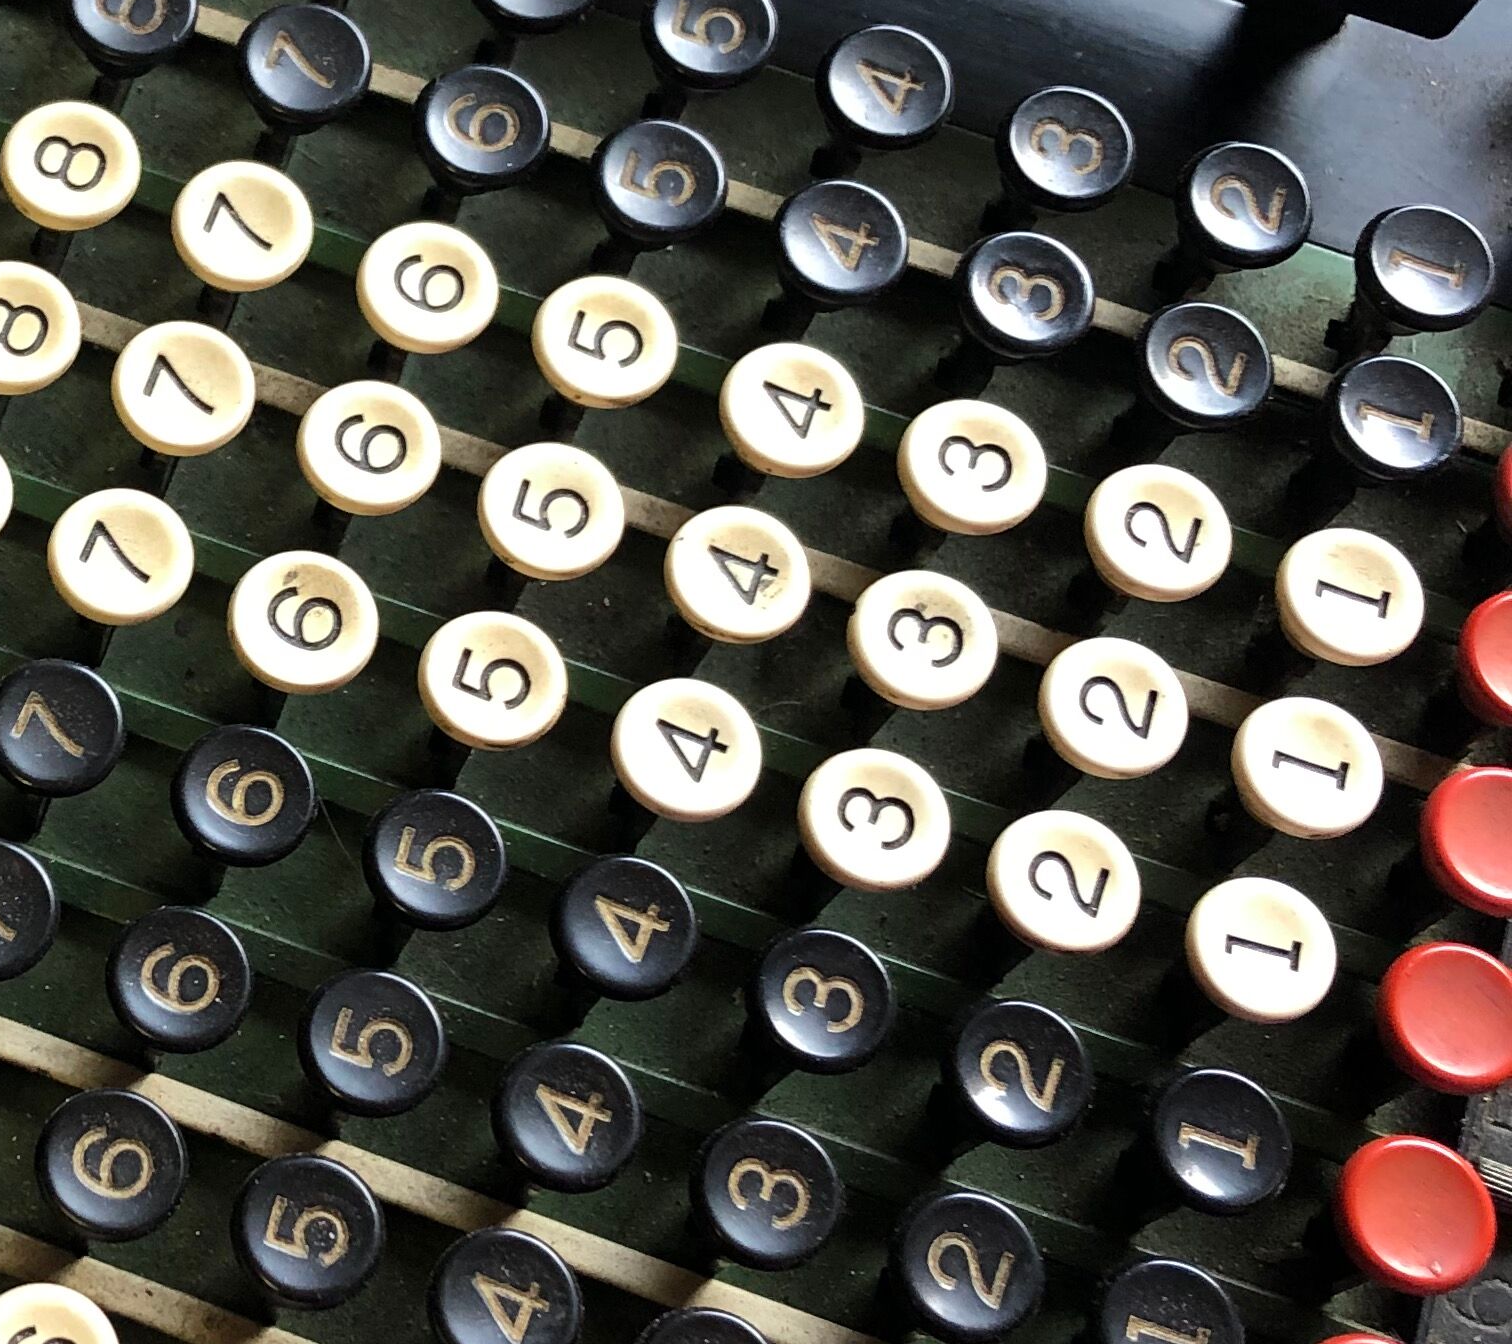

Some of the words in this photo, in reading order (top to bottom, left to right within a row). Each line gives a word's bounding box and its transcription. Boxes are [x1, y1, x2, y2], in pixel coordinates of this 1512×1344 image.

[266, 30, 335, 90] 7
[855, 60, 925, 116] 4
[447, 93, 521, 152] 6
[1031, 116, 1103, 175] 3
[34, 136, 107, 192] 8
[624, 151, 696, 206] 5
[204, 192, 273, 252] 7
[1210, 176, 1286, 234] 2
[810, 212, 880, 273] 4
[1392, 249, 1467, 291] 1
[394, 254, 465, 312] 6
[989, 265, 1066, 322] 3
[569, 310, 644, 368] 5
[1168, 336, 1246, 398] 2
[144, 354, 215, 416] 7
[763, 382, 833, 439] 4
[335, 414, 408, 474] 6
[1359, 403, 1435, 444] 1
[938, 435, 1012, 493] 3
[512, 479, 590, 539] 5
[1124, 502, 1203, 564] 2
[80, 521, 150, 584] 7
[709, 545, 779, 605] 4
[267, 586, 343, 651] 6
[1315, 578, 1391, 619] 1
[888, 607, 963, 668] 3
[455, 648, 532, 711] 5
[1079, 677, 1157, 740] 2
[12, 692, 85, 758] 7
[657, 718, 729, 782] 4
[205, 759, 285, 826] 6
[1271, 750, 1351, 790] 1
[837, 787, 915, 851] 3
[394, 826, 475, 892] 5
[1028, 850, 1110, 918] 2
[594, 895, 669, 963] 4
[1224, 933, 1303, 973] 1
[141, 944, 219, 1014] 6
[782, 965, 864, 1034] 3
[330, 1006, 413, 1077] 5
[979, 1039, 1064, 1112] 2
[537, 1083, 612, 1154] 4
[1179, 1122, 1259, 1172] 1
[71, 1127, 154, 1199] 6
[728, 1158, 811, 1230] 3
[263, 1195, 348, 1267] 5
[926, 1231, 1015, 1309] 2
